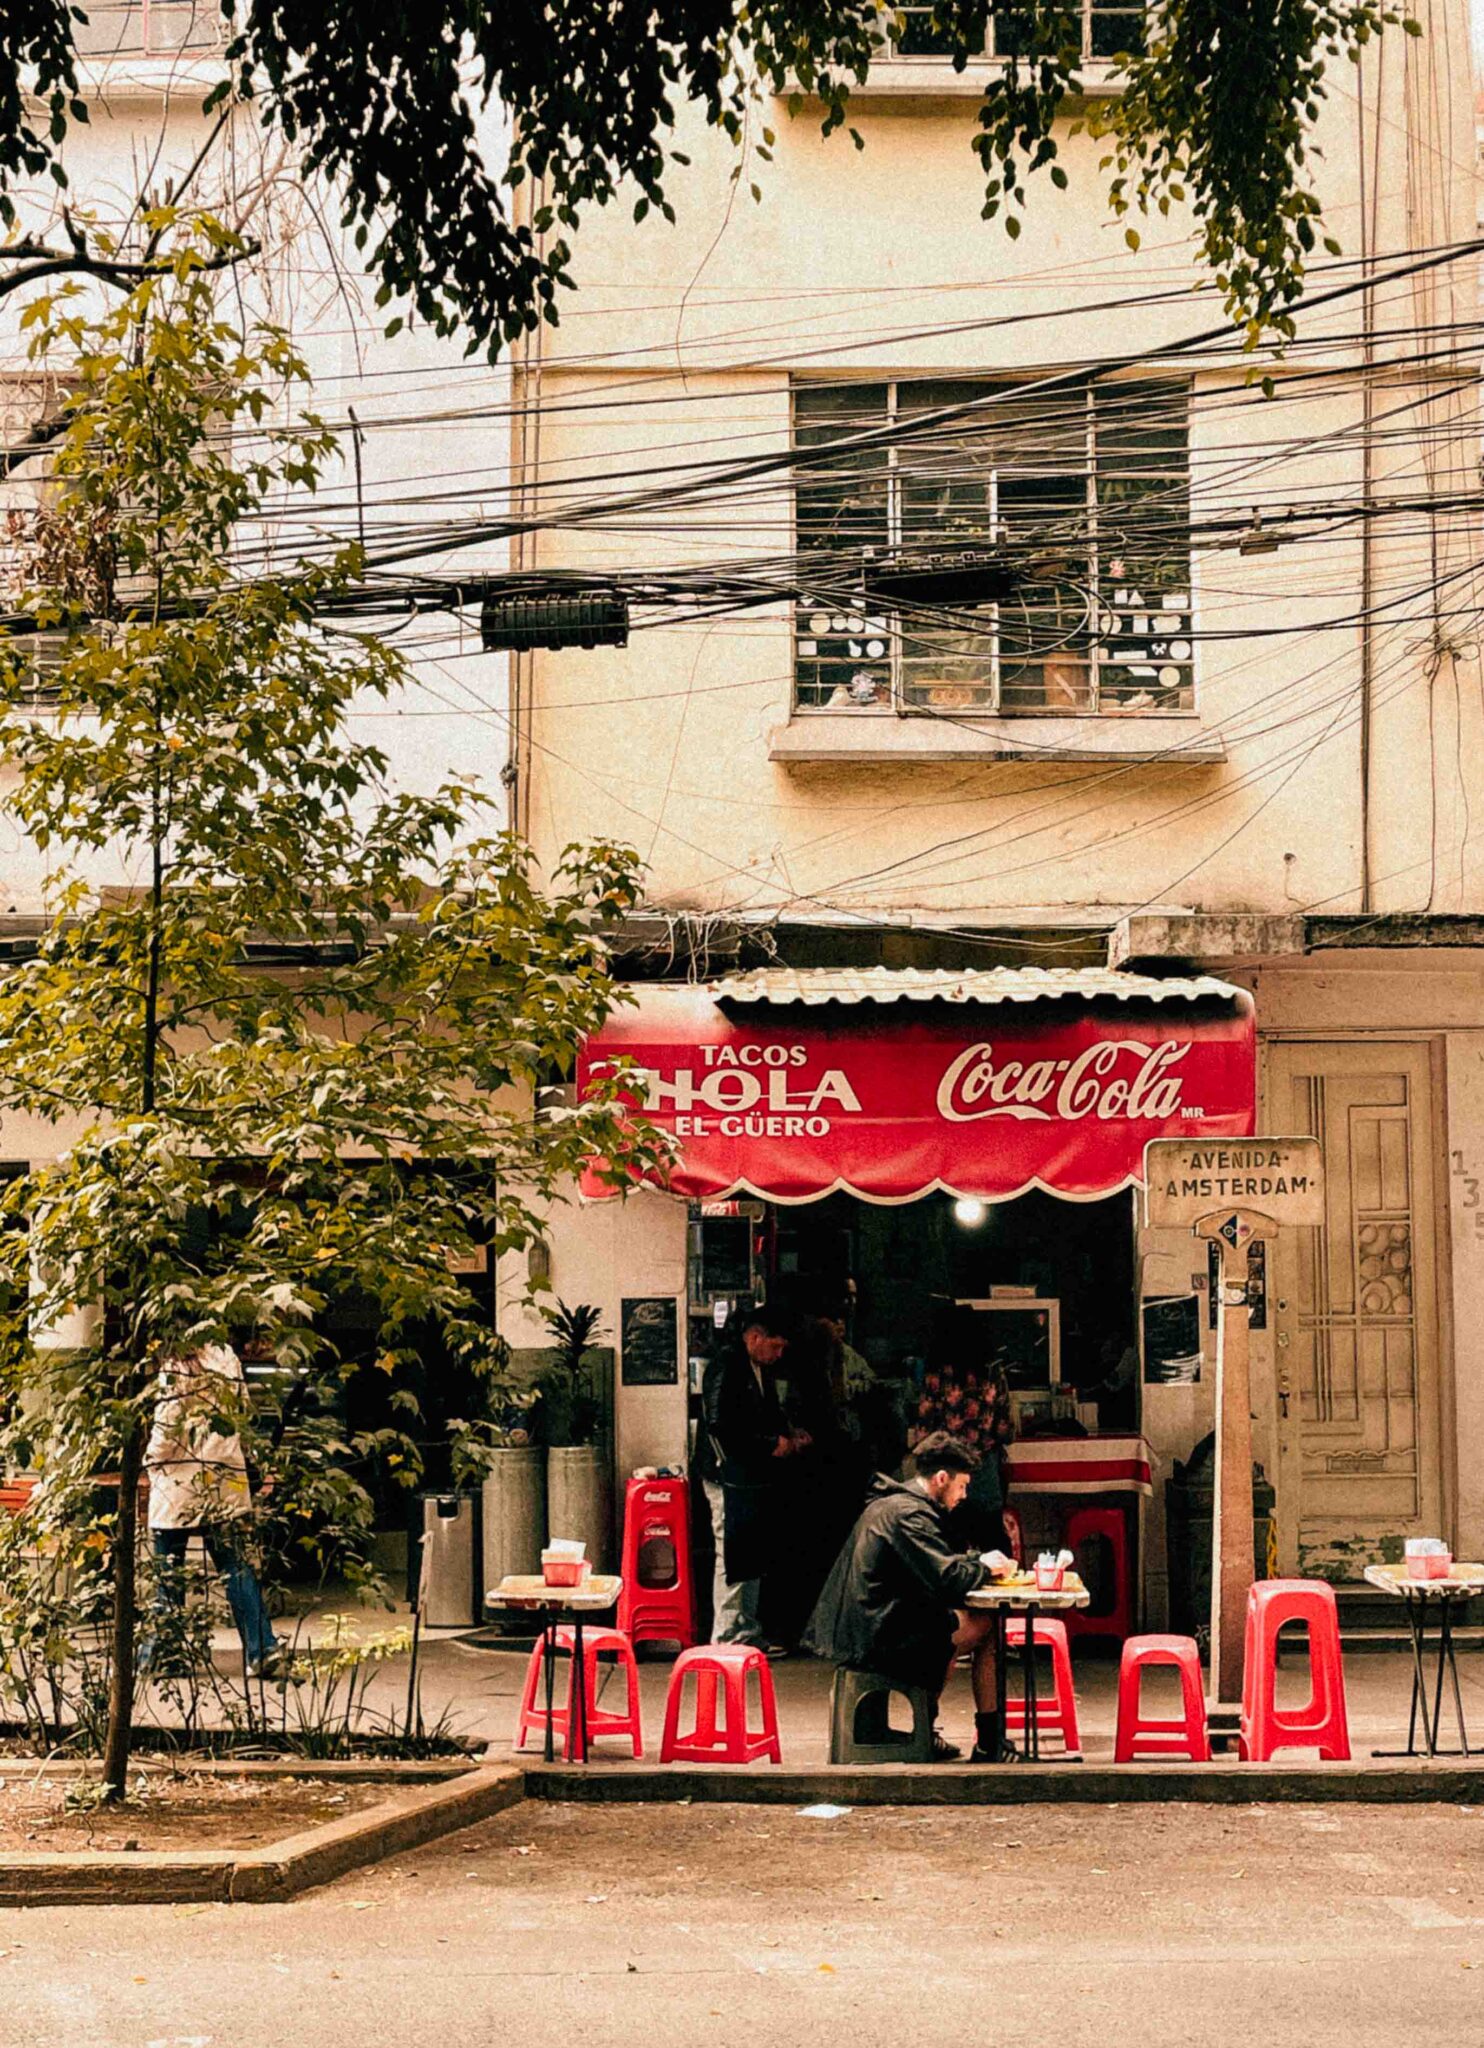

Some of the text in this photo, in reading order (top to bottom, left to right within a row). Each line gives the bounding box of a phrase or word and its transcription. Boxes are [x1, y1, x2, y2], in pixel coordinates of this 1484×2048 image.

[700, 1044, 808, 1067] TACOS
[642, 1069, 863, 1112] HOLA
[937, 1040, 1206, 1122] Coca-Cola MR
[675, 1111, 831, 1138] EL GÜERO
